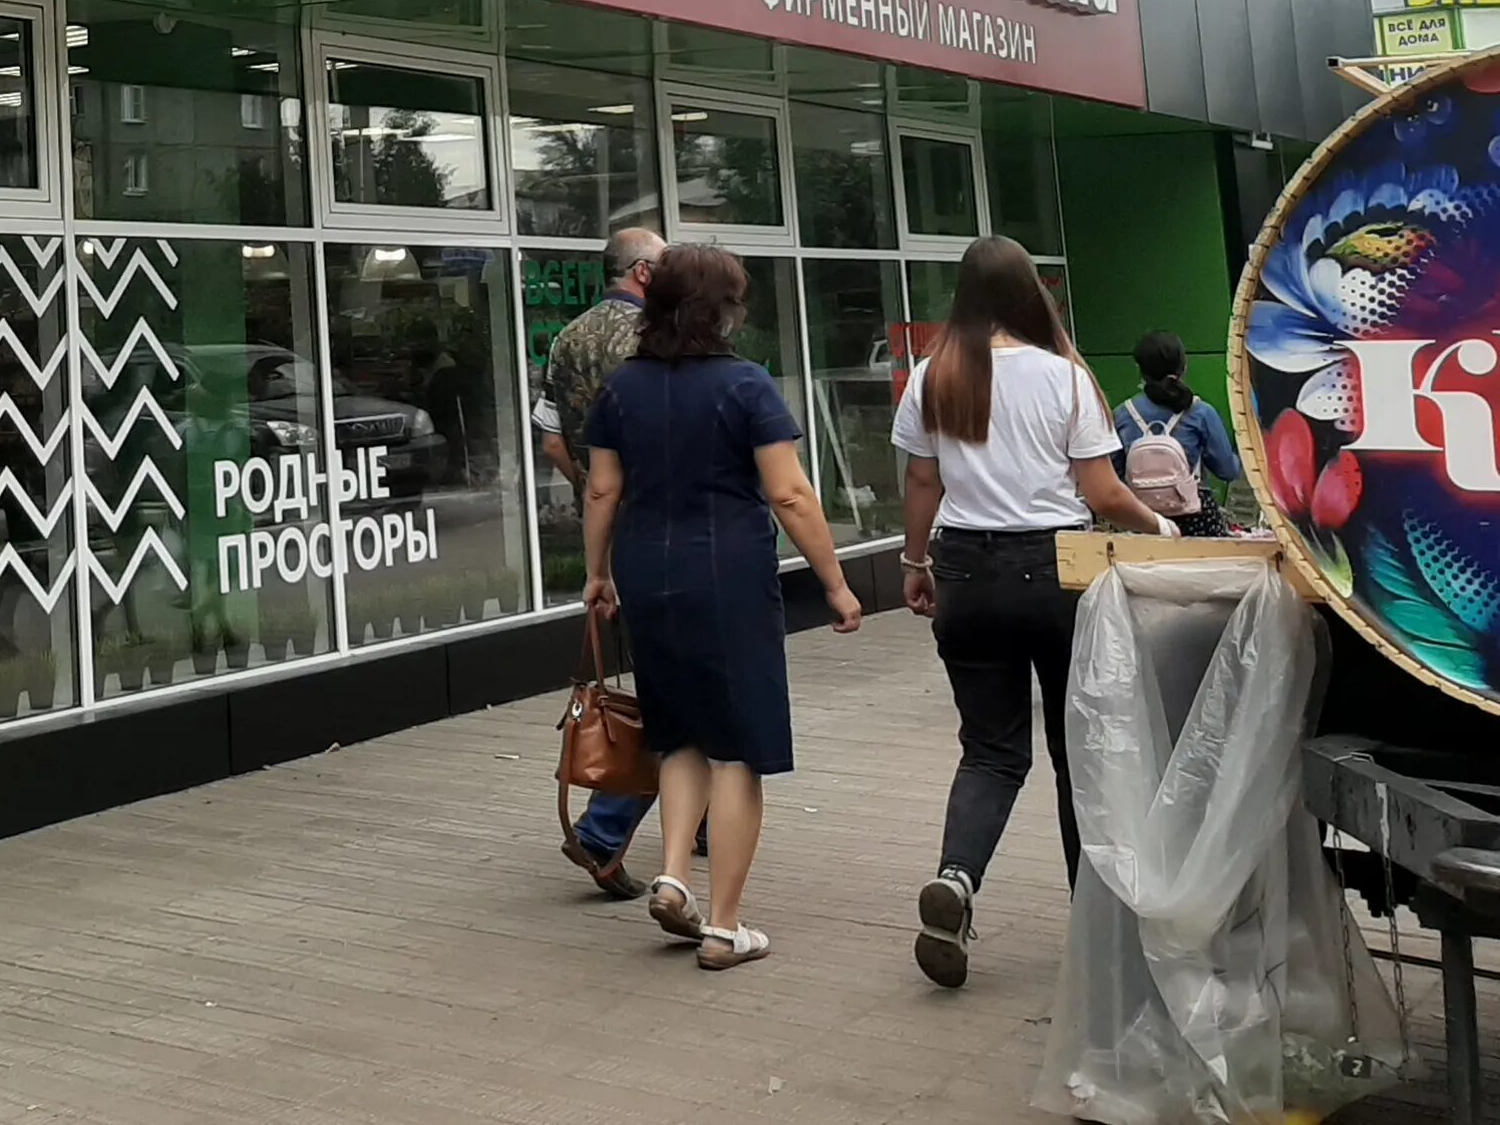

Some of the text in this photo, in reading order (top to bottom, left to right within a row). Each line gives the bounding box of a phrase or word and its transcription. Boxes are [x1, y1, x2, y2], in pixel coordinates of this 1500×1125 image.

[938, 3, 1037, 65] МАГАЗИН
[1398, 33, 1440, 47] ДОМА
[1419, 18, 1446, 31] ДЛЯ
[213, 445, 391, 523] РОДНЫЕ
[217, 507, 438, 595] ПРОСТОРЫ
